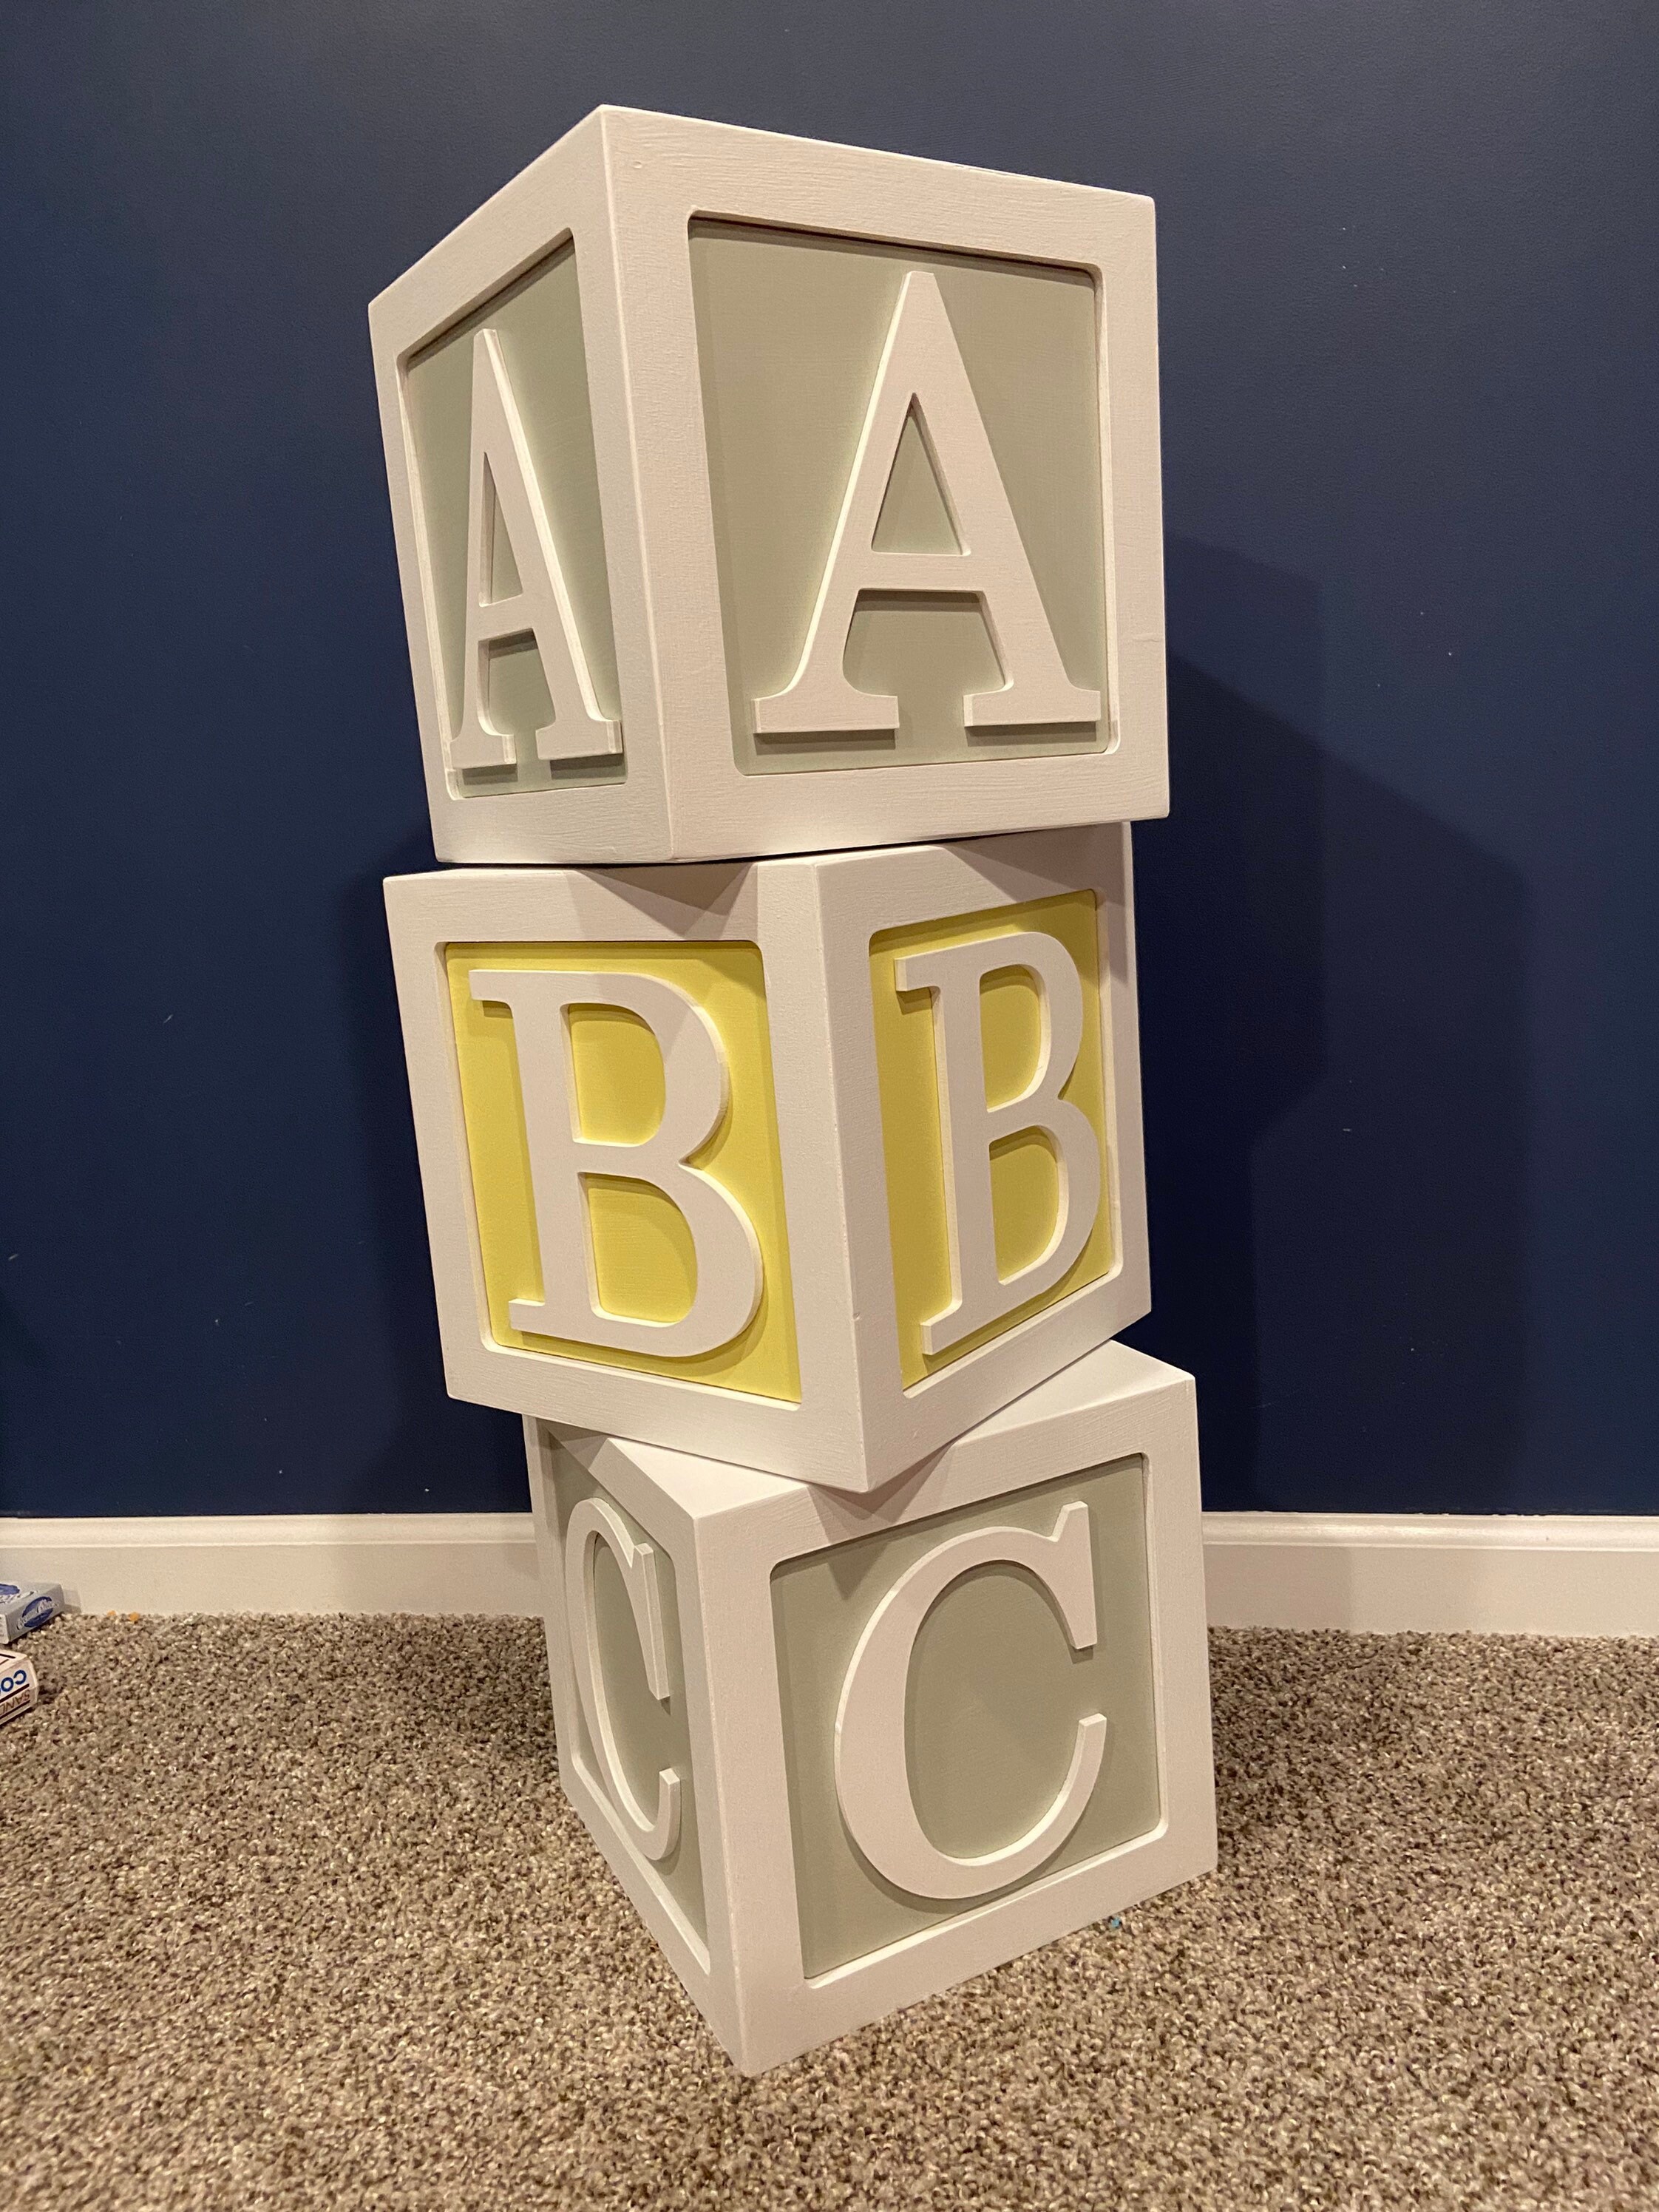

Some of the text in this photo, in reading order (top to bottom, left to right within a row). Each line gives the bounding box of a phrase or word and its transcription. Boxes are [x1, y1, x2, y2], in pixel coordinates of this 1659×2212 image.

[449, 329, 622, 769] A
[751, 271, 1101, 733] A
[469, 968, 763, 1357] B
[895, 932, 1100, 1355] B
[0, 1669, 27, 1694] CO
[566, 1498, 680, 1861] C
[834, 1501, 1107, 1899] C
